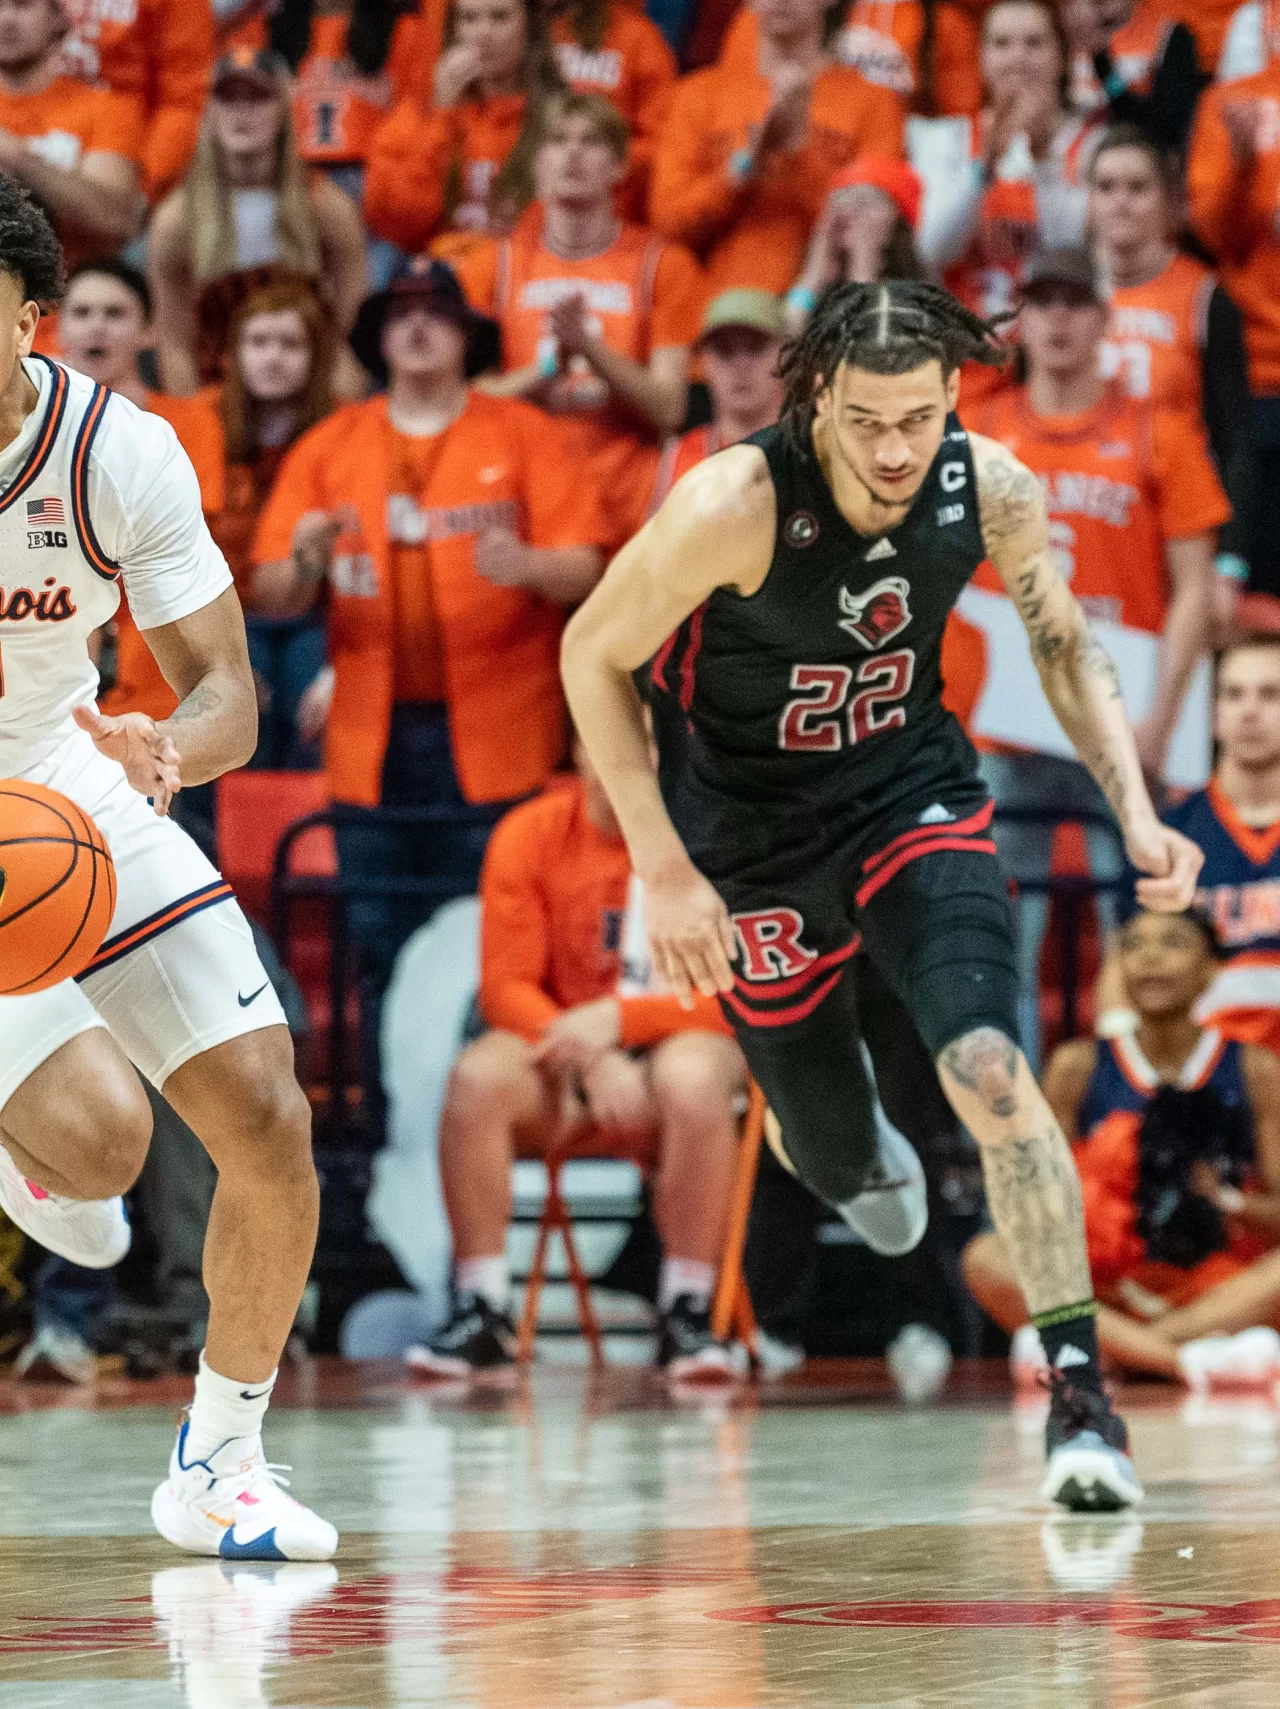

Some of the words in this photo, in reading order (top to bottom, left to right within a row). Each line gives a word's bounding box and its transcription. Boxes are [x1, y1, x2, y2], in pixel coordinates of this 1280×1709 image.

[940, 461, 966, 492] C
[777, 648, 915, 751] 22
[730, 907, 819, 981] R
